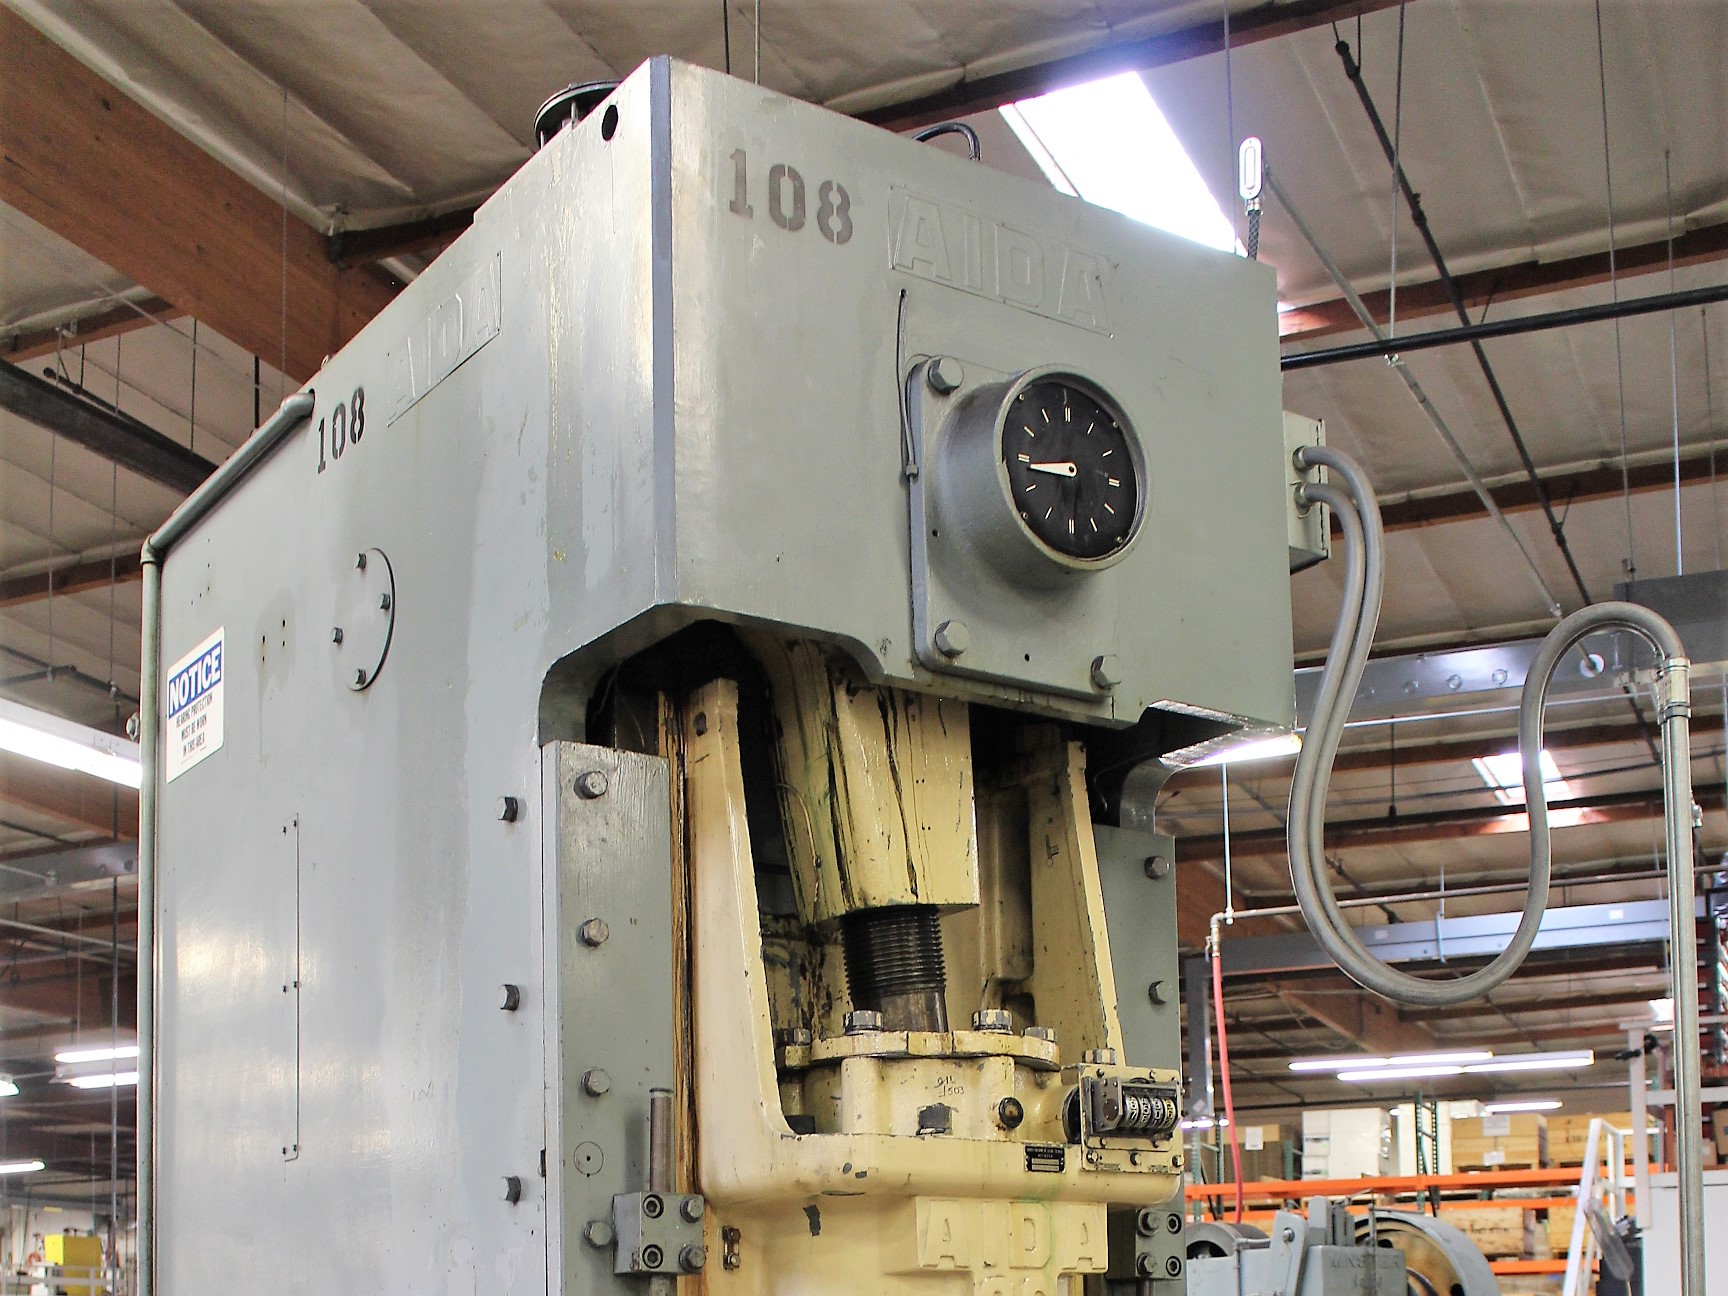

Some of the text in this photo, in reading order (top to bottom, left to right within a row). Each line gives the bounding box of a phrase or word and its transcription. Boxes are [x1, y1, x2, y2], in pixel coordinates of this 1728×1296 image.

[729, 148, 854, 246] 108
[892, 193, 1113, 331] AIDA
[317, 387, 366, 475] 108
[169, 645, 222, 715] NOTICE
[920, 1199, 1107, 1270] AIDA
